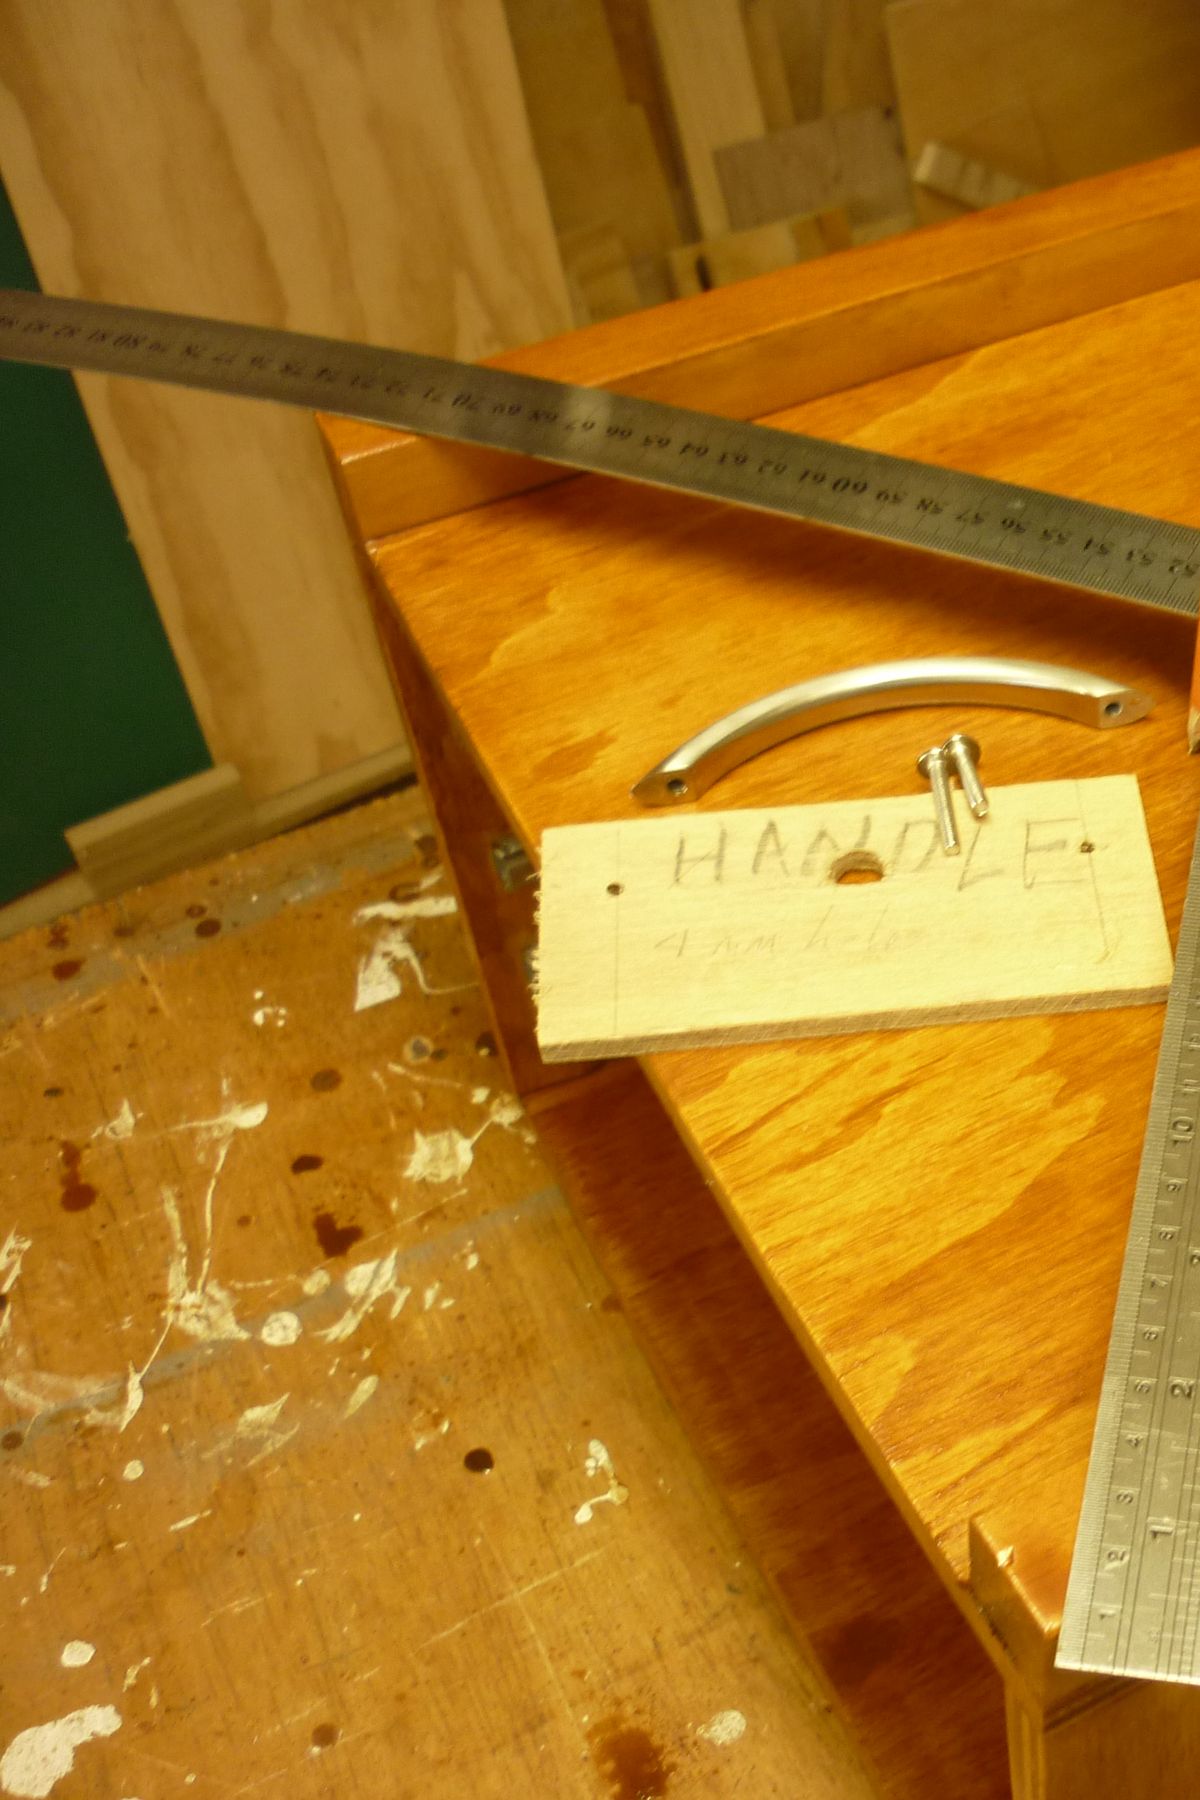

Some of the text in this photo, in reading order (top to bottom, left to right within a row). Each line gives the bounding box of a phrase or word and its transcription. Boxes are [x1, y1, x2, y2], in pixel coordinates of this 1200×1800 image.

[672, 814, 1092, 892] HANDLE
[1170, 1116, 1194, 1145] 10
[1166, 1180, 1181, 1192] 9
[1159, 1227, 1175, 1240] 8
[1150, 1277, 1168, 1288] 7
[1142, 1328, 1159, 1340] 6
[1134, 1381, 1150, 1393] 5
[1124, 1434, 1142, 1448] 4
[1148, 1522, 1174, 1542] 1
[1170, 1381, 1194, 1399] 2
[1117, 1490, 1134, 1504] 3
[1108, 1549, 1129, 1561] 2
[1100, 1610, 1116, 1620] 1
